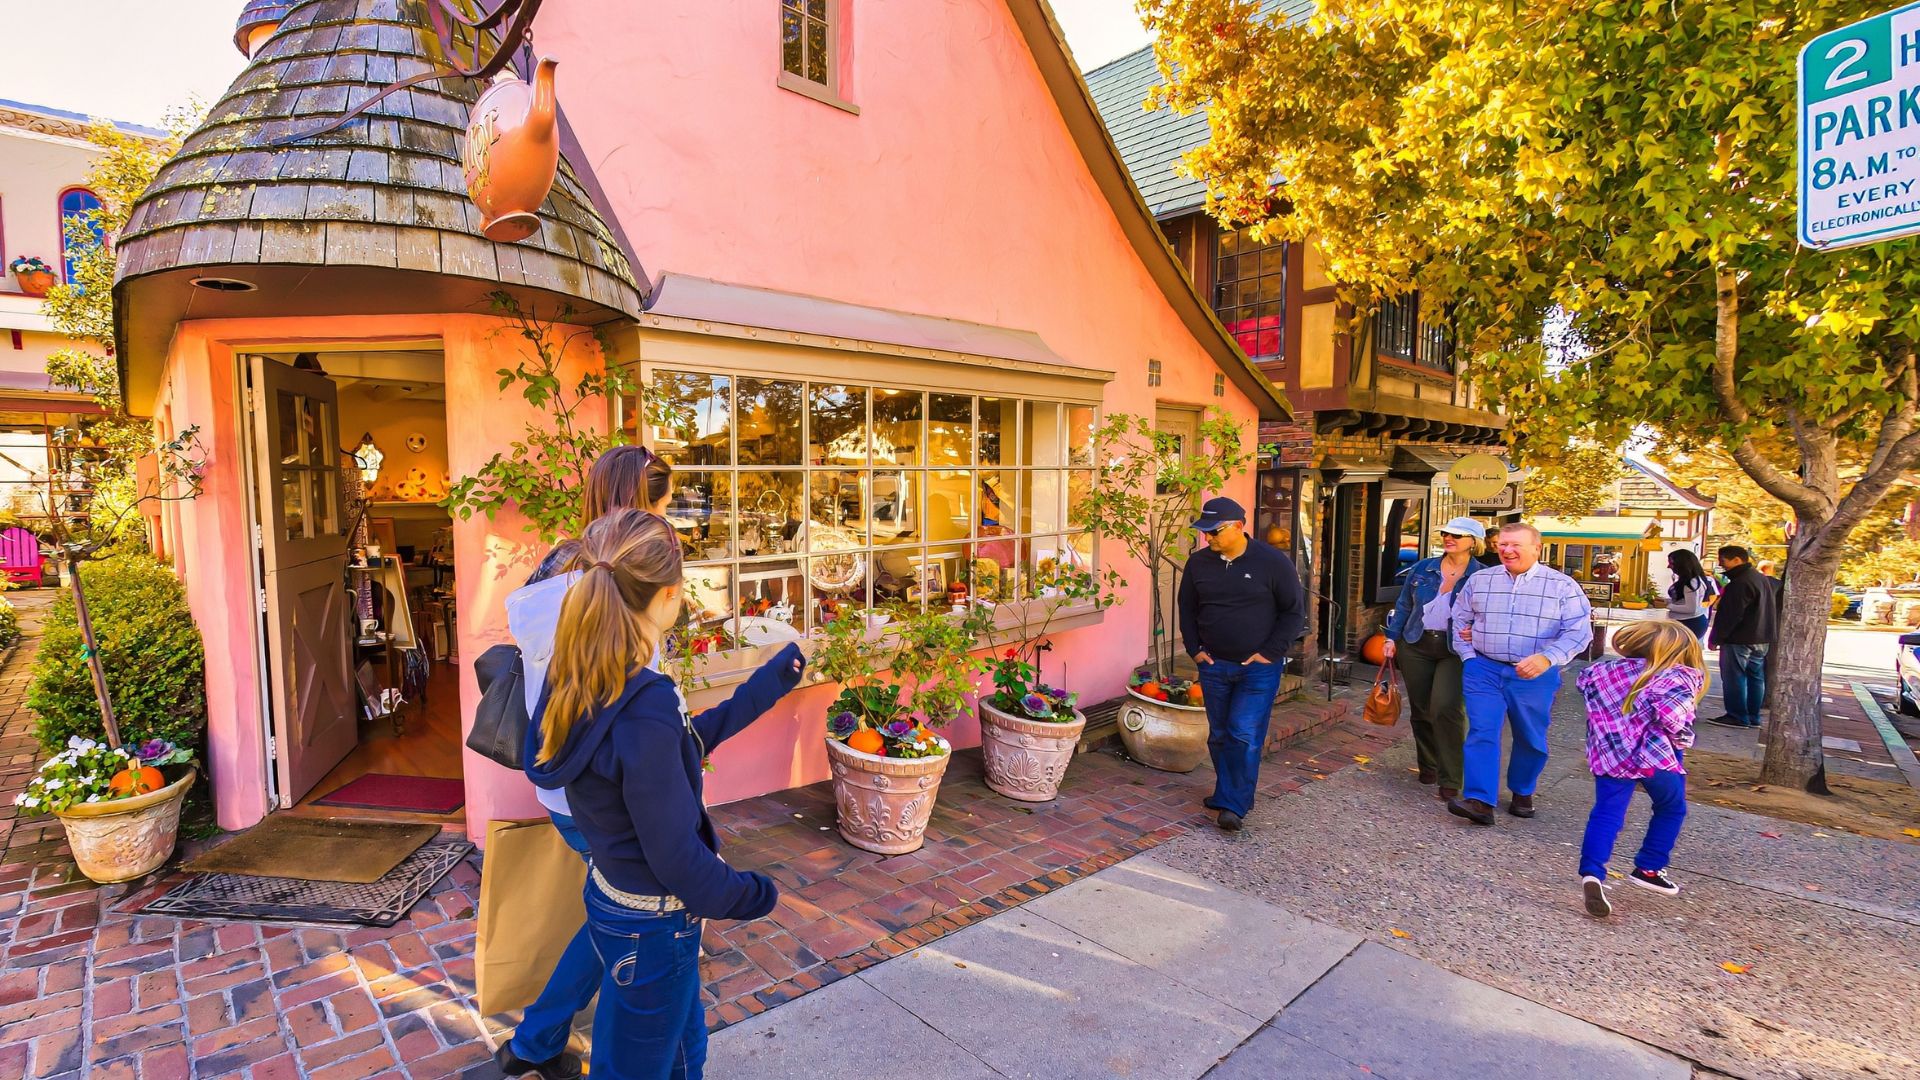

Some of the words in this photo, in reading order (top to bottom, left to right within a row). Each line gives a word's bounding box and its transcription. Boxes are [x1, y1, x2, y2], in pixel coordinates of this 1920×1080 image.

[1824, 38, 1869, 91] 2
[1814, 85, 1920, 151] PARK
[1896, 146, 1916, 160] TO
[1838, 179, 1916, 209] EVERY
[1465, 497, 1505, 505] ALLERY
